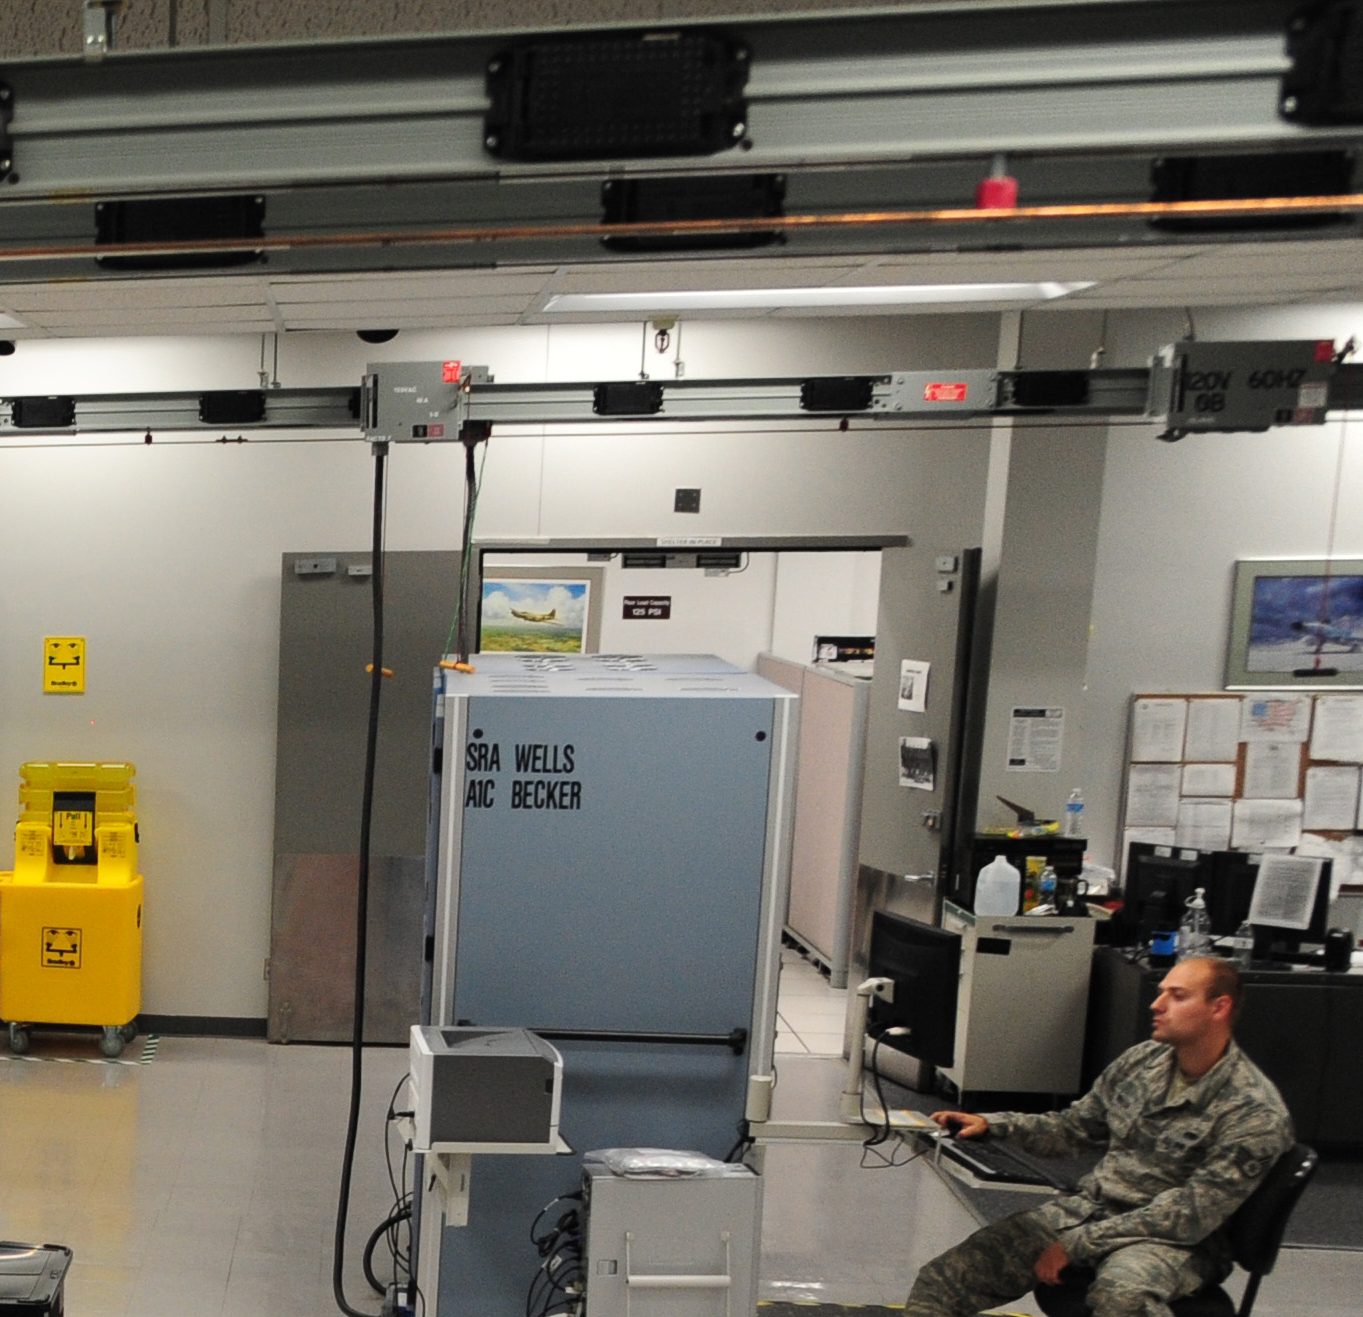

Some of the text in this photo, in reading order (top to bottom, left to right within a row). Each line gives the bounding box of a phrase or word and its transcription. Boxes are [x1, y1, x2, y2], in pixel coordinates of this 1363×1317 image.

[1248, 367, 1306, 390] 60HZ
[466, 742, 575, 774] SRA WELLS
[465, 779, 582, 810] A1C BECKER
